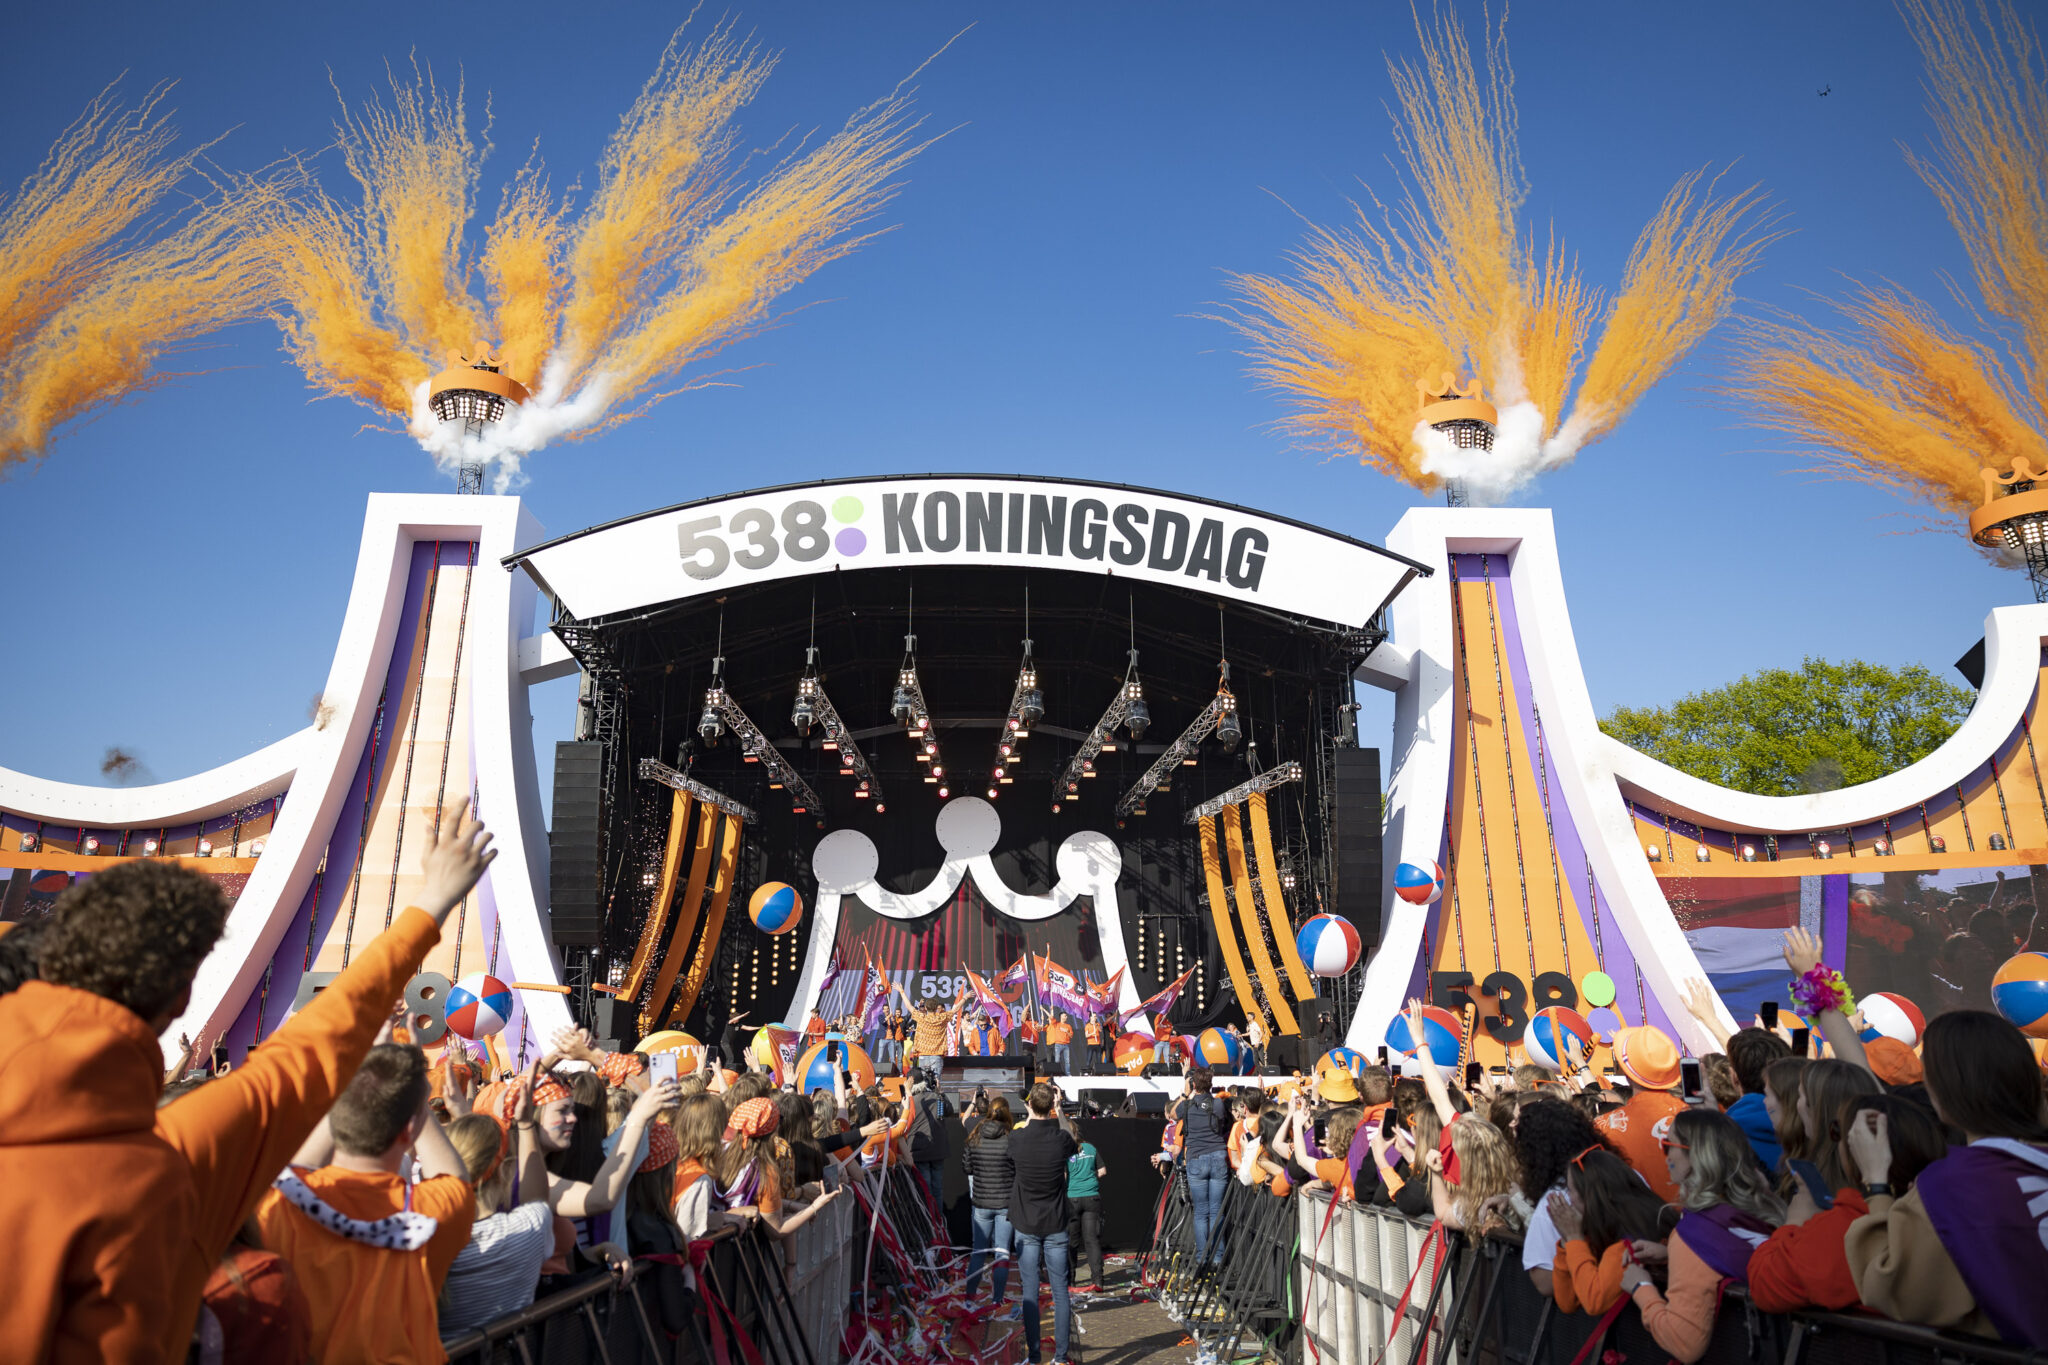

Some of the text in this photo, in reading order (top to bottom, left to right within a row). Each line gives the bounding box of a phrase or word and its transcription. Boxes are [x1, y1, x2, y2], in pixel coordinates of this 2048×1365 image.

[678, 491, 1269, 592] 538 KONINGSDAG
[921, 975, 967, 998] 538
